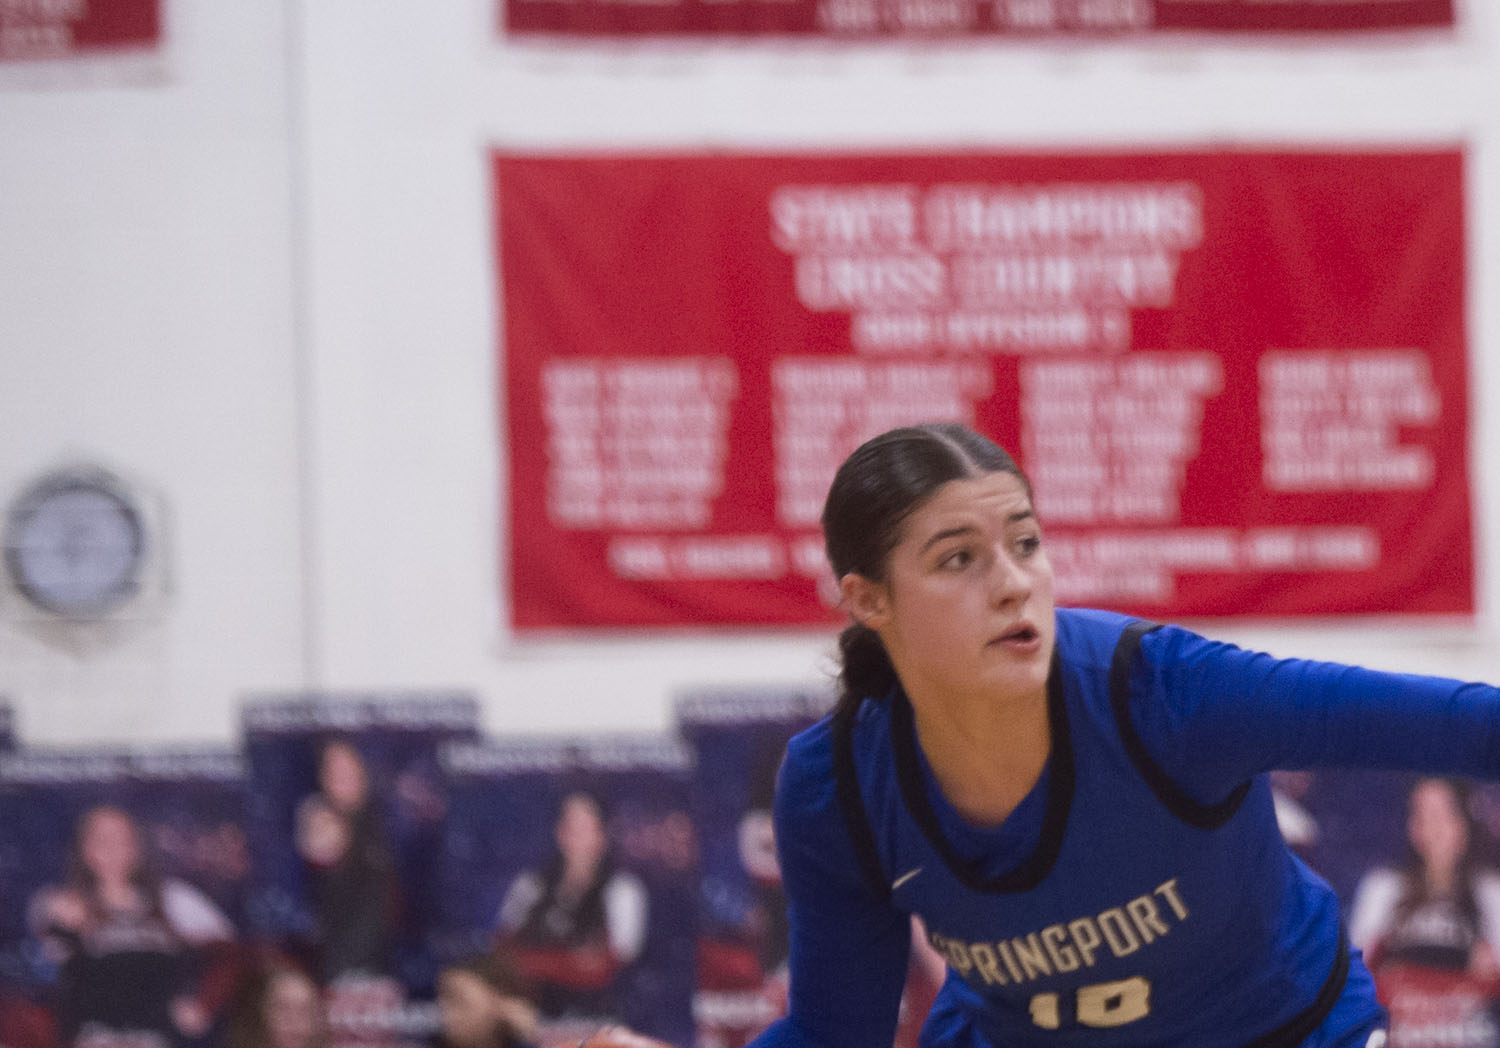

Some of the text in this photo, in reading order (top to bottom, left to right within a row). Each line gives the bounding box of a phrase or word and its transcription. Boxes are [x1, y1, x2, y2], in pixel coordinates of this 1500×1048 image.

[771, 184, 1202, 250] STATE CHAMPIONS
[797, 247, 1178, 308] CROSS COUNTRY
